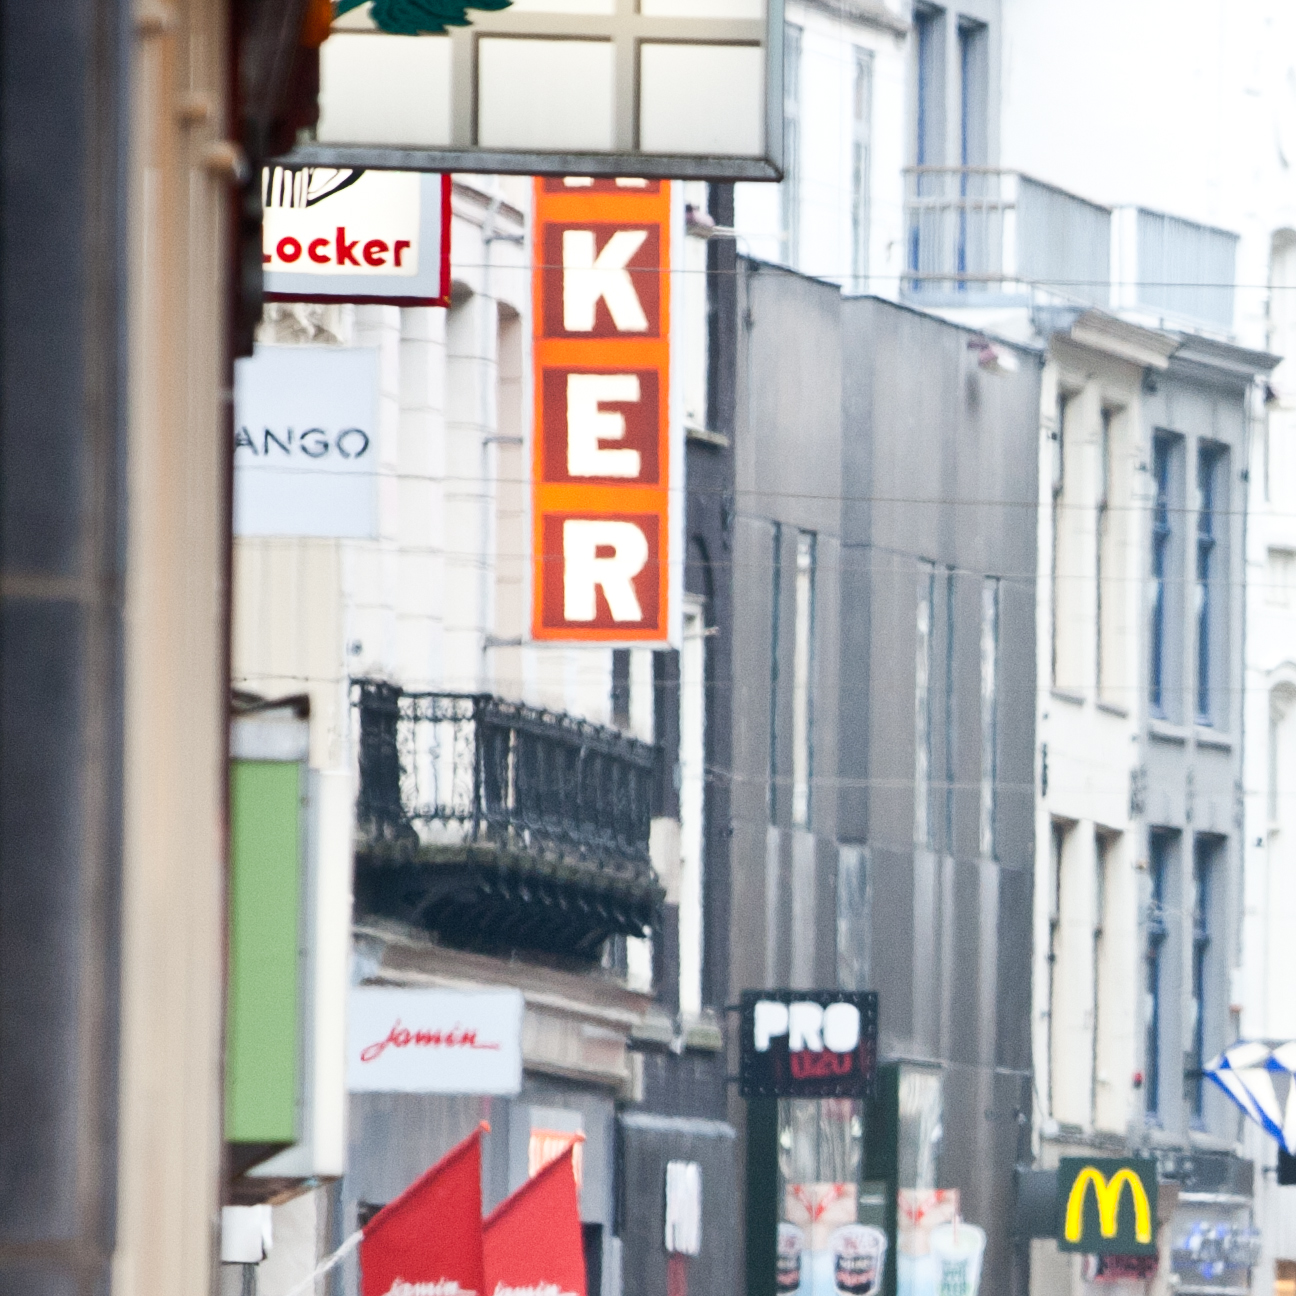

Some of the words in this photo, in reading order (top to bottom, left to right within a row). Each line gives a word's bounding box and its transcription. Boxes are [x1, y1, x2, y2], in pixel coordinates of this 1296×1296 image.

[562, 177, 650, 623] KER
[236, 425, 370, 459] ANGO
[753, 998, 860, 1053] PRO
